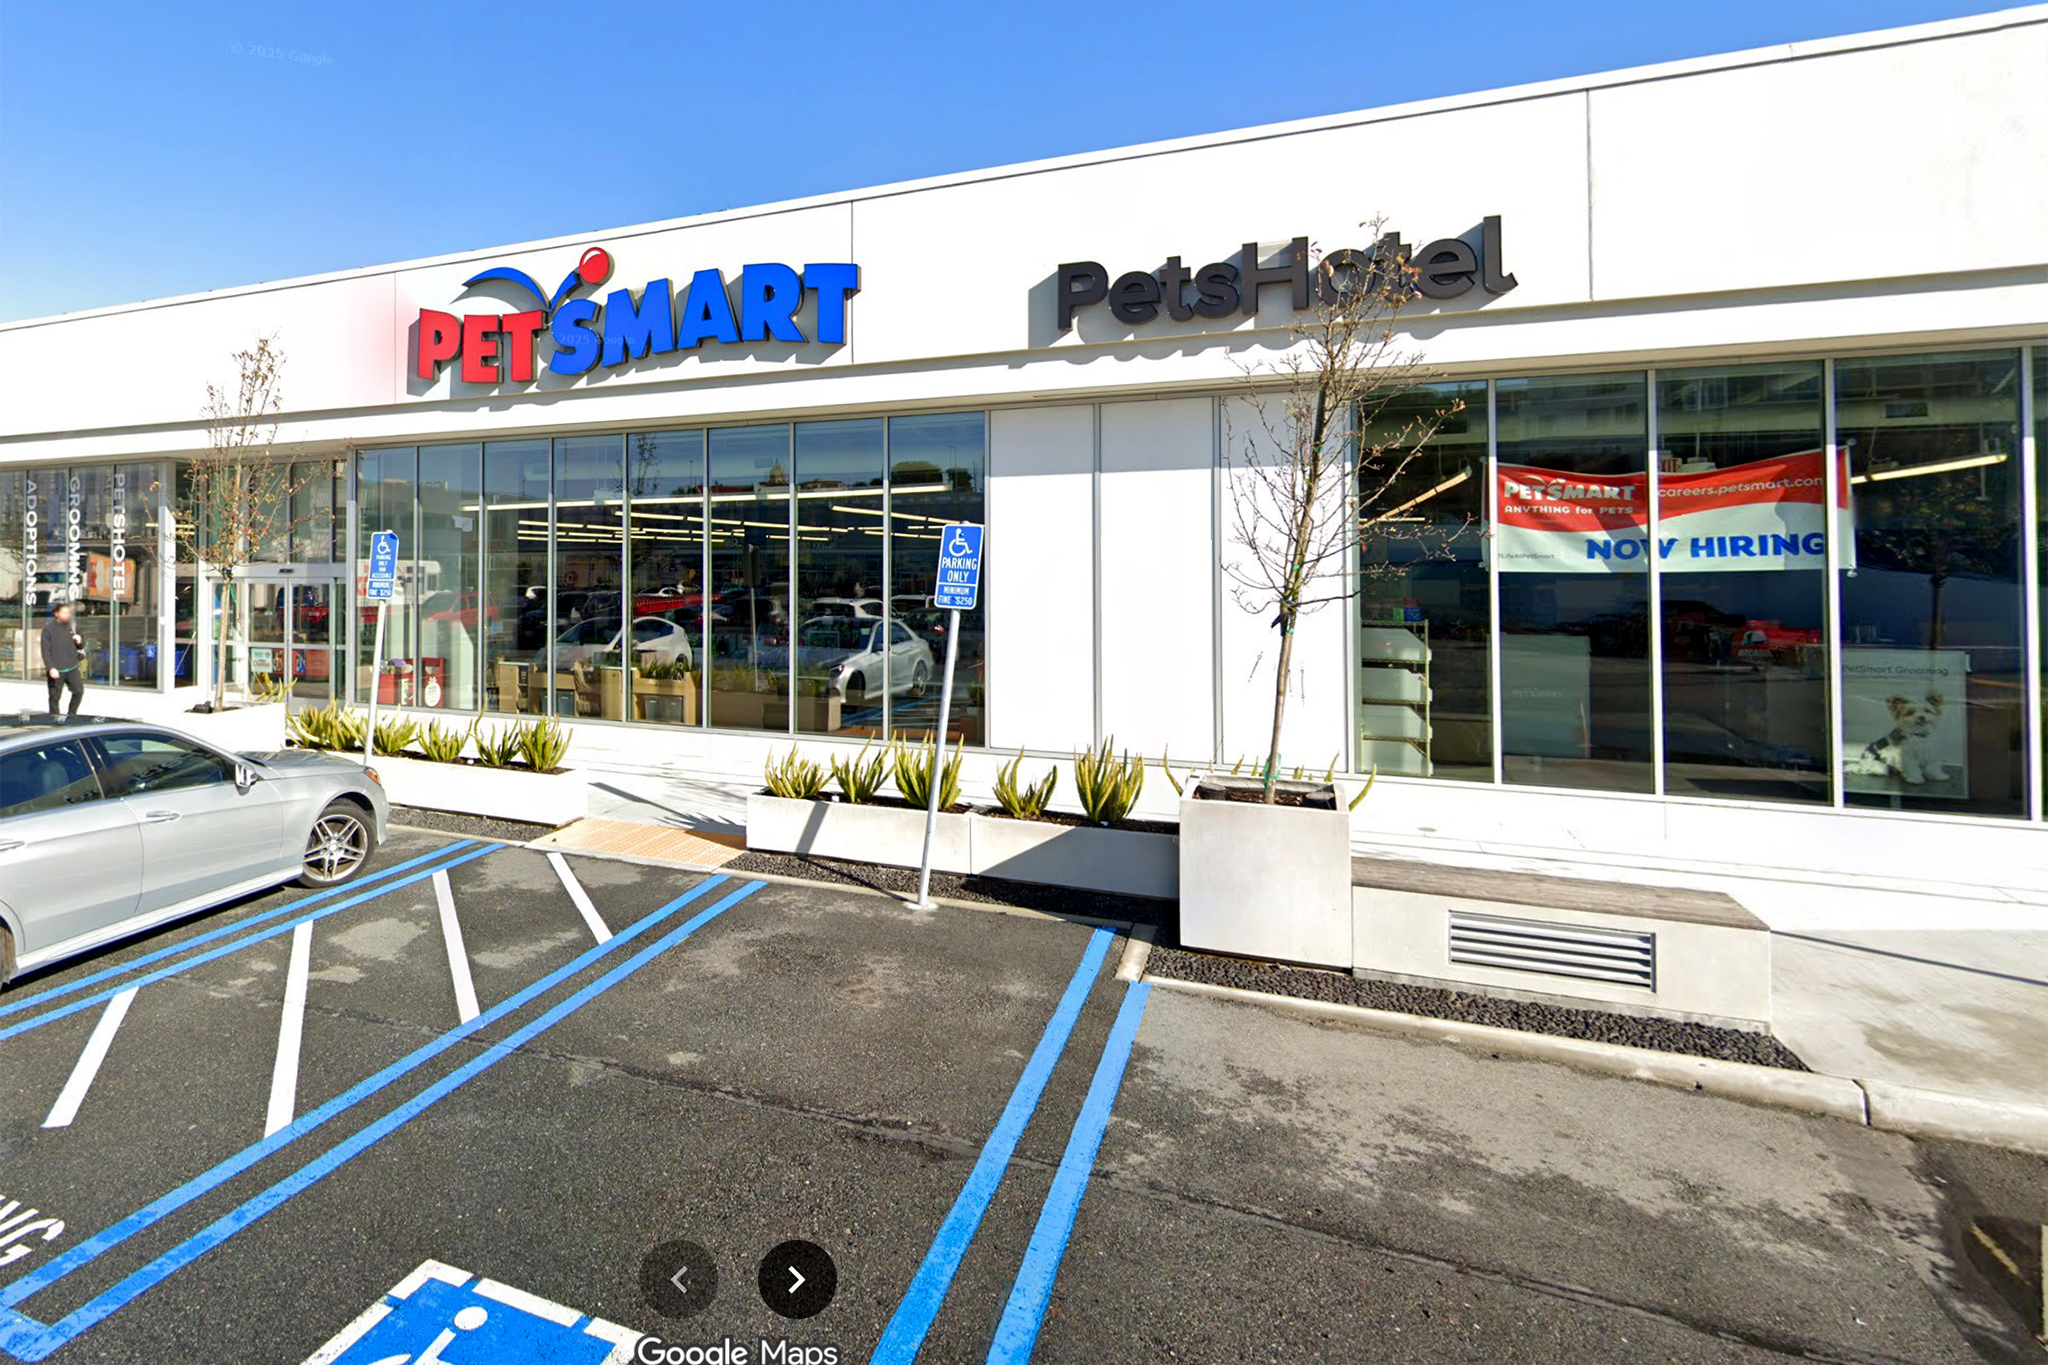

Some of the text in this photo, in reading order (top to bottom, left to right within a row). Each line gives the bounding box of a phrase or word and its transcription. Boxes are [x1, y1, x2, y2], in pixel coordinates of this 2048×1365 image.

[1056, 214, 1519, 332] PetsHotel
[417, 261, 863, 385] PETSMART
[1503, 480, 1636, 501] PETSMART
[1504, 505, 1634, 515] ANYTHING for PETS
[26, 479, 38, 606] ADOPTIONS
[68, 477, 81, 601] GROOMING
[112, 473, 126, 602] PETSHOTEL
[1584, 532, 1825, 560] NOW HIRING
[942, 557, 977, 570] PARKING
[947, 570, 970, 582] ONLY
[938, 595, 973, 606] FINE $250
[943, 587, 969, 595] MINIMUM
